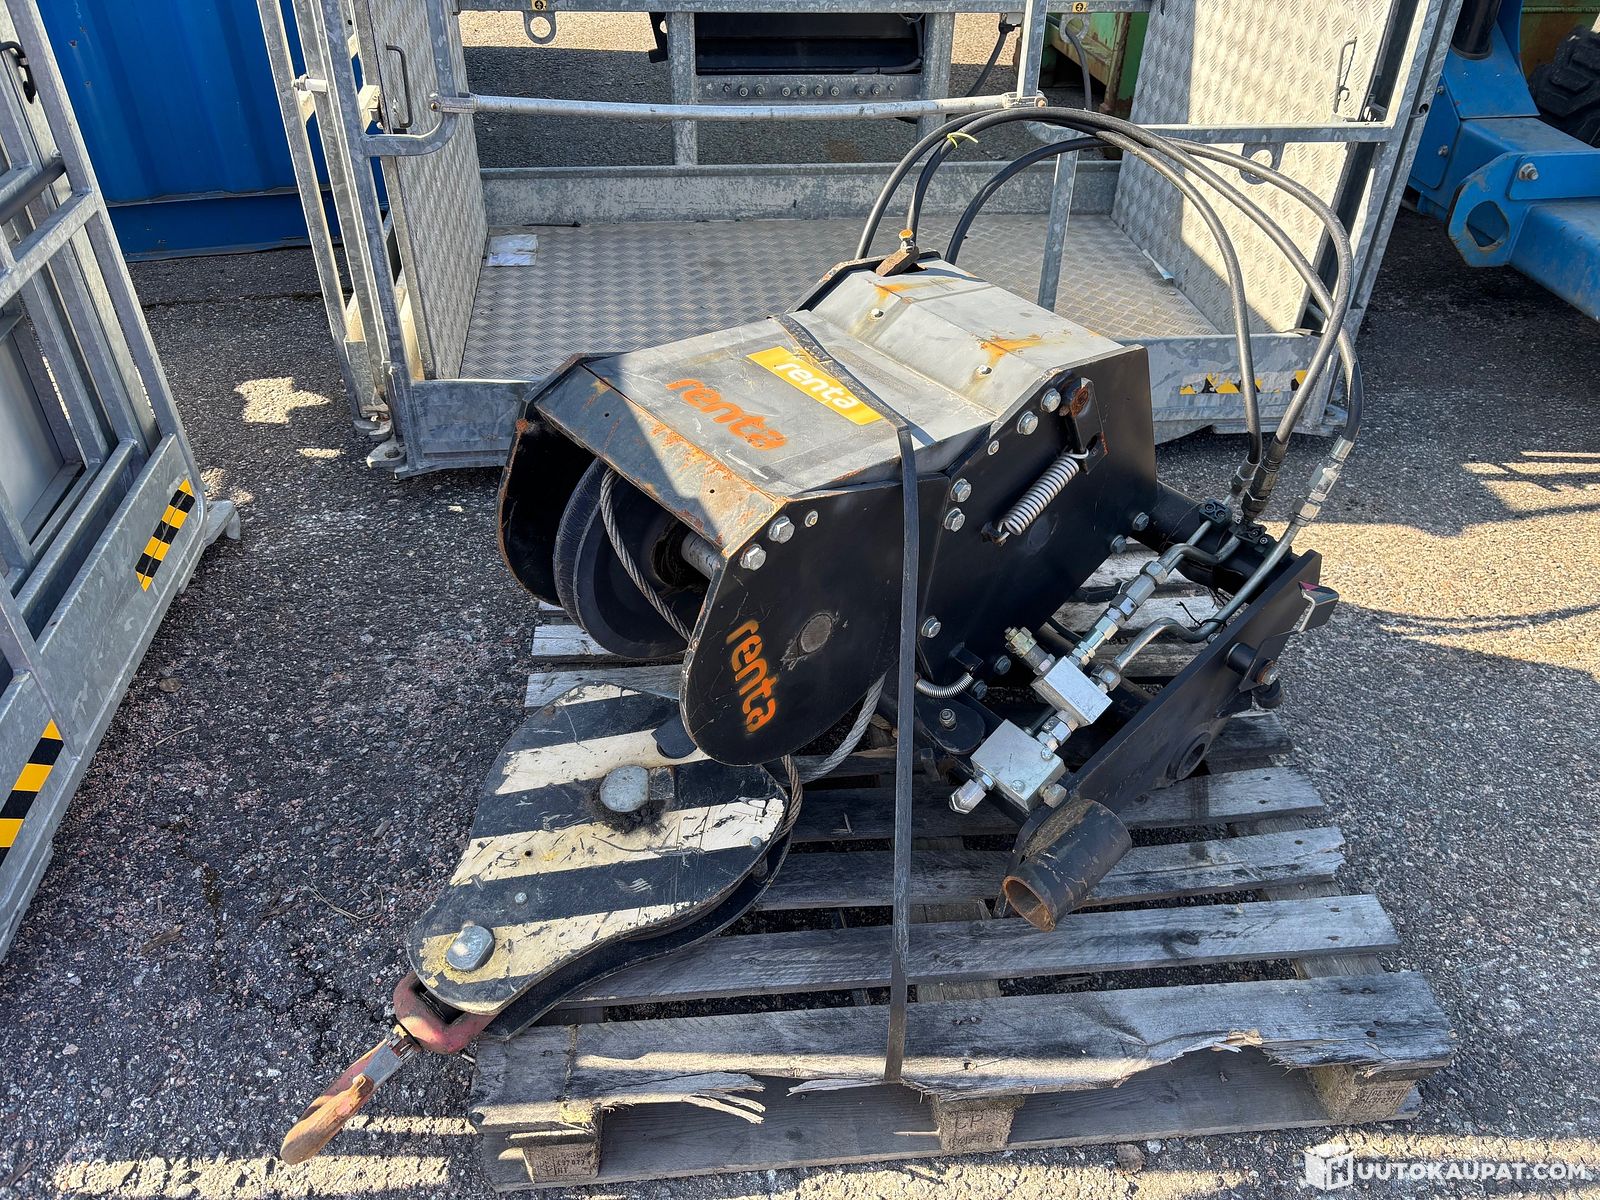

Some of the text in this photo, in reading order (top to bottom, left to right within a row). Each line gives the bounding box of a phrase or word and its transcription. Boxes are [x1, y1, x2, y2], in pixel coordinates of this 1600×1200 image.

[665, 378, 788, 450] renta
[775, 362, 859, 410] renta
[725, 619, 777, 733] renta
